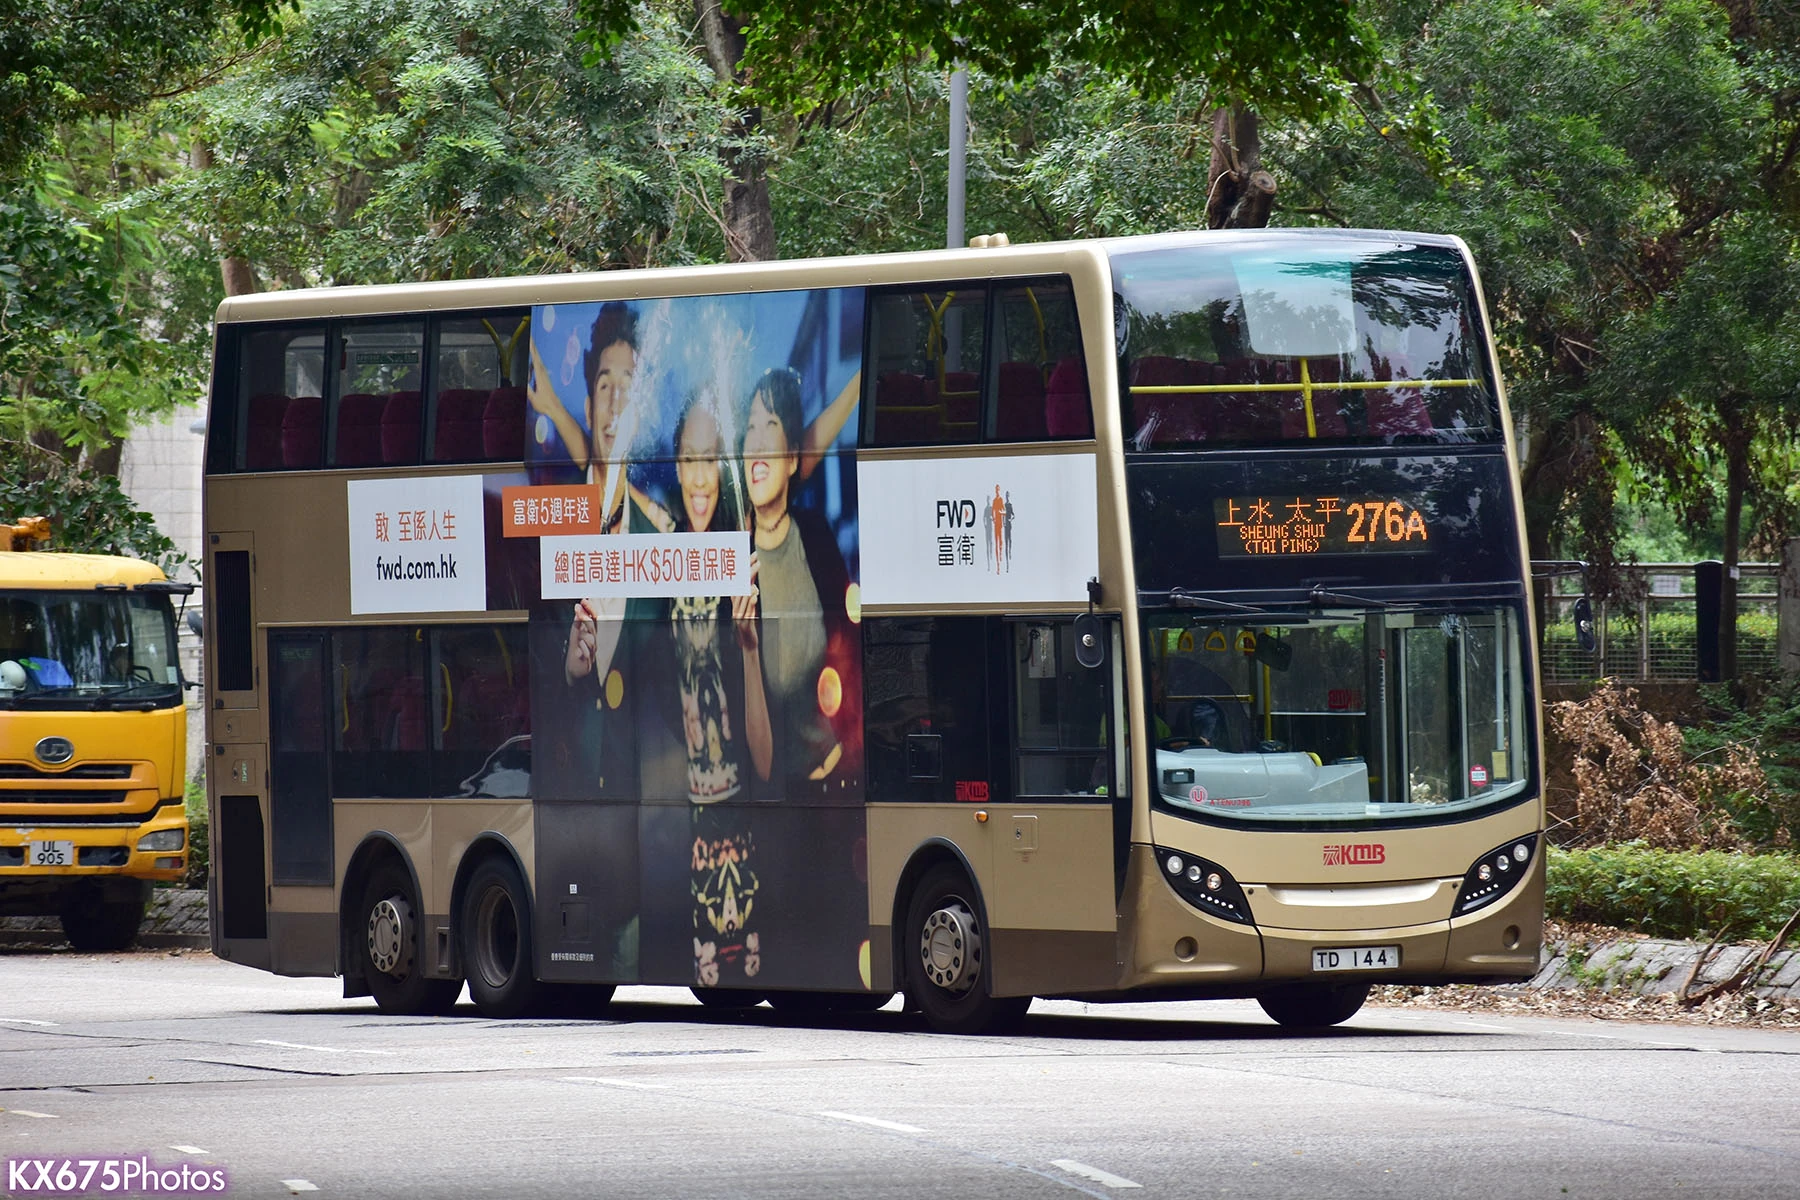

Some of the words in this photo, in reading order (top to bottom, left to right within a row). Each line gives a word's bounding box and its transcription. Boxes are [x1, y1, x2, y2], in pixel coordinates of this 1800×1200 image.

[512, 497, 590, 526] 富衛5週年送
[936, 500, 976, 528] FWD
[1218, 498, 1273, 526] 上水
[1285, 497, 1341, 524] 太平
[1346, 502, 1427, 542] 276A
[375, 512, 389, 542] 敢
[398, 509, 456, 541] 至係人生
[1239, 524, 1289, 541] SHEUNG
[1294, 523, 1325, 538] SHUI
[937, 533, 975, 566] 富衛
[1245, 539, 1276, 554] (TAI
[1281, 538, 1320, 553] PING)
[376, 553, 457, 580] fwd.com.hk
[554, 546, 737, 585] 總值高達HK$50億保障
[40, 743, 69, 756] UD
[967, 781, 989, 801] KMB
[37, 853, 65, 865] 905
[42, 841, 60, 853] UL
[1341, 844, 1386, 865] KMB
[1317, 952, 1340, 968] TD
[1353, 949, 1388, 967] 144
